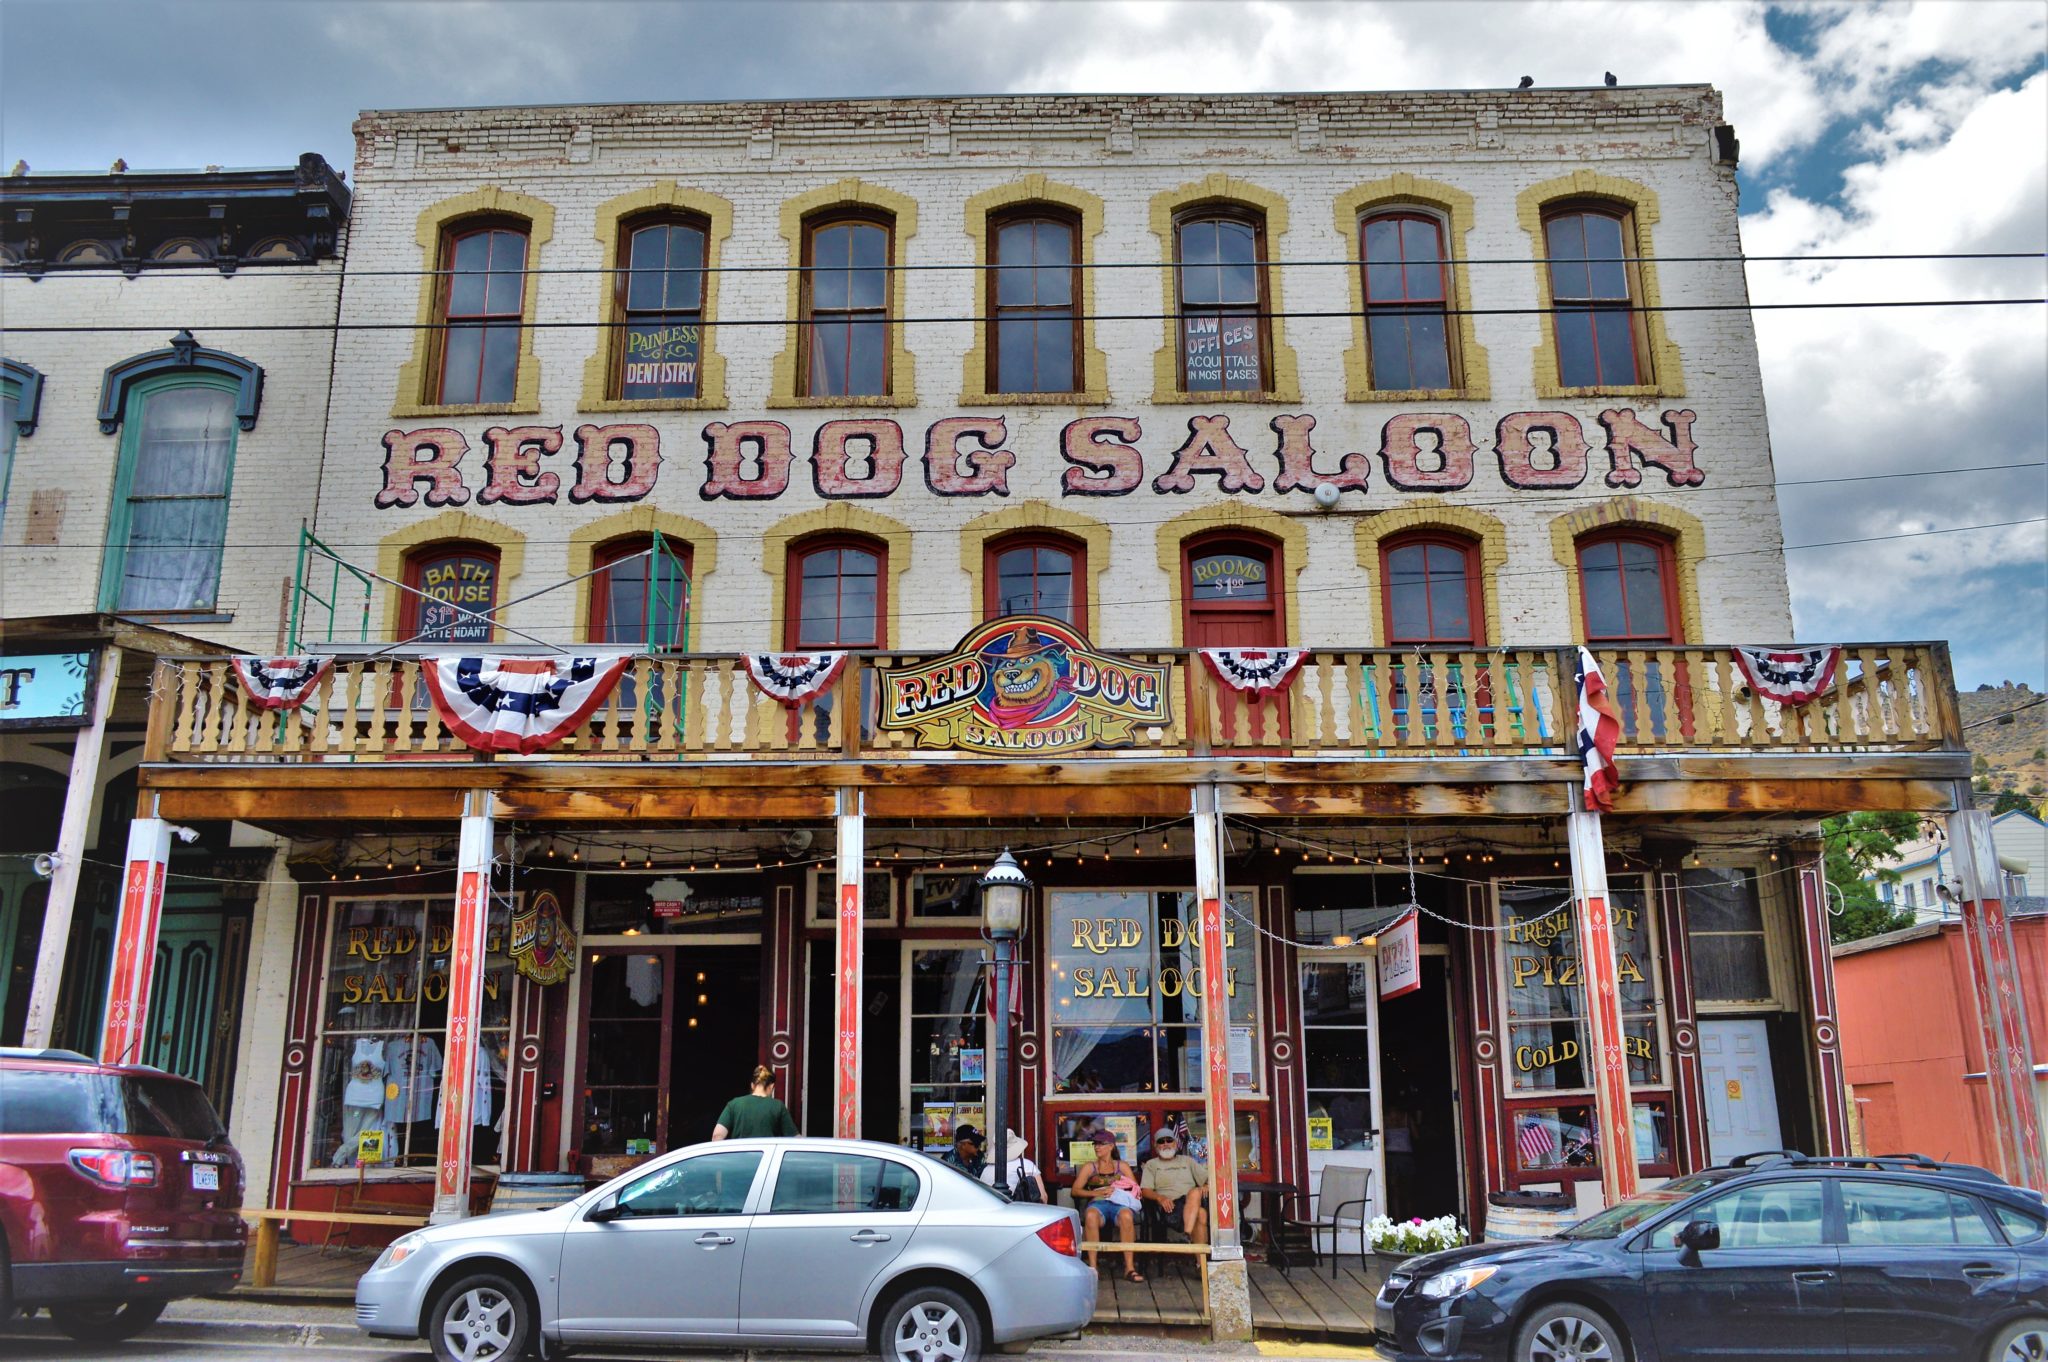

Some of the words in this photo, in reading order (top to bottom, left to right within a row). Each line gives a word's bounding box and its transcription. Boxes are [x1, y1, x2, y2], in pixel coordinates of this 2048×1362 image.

[628, 326, 699, 353] PAINLESS
[1187, 317, 1219, 333] LAW
[1187, 325, 1254, 354] OFFICES
[626, 362, 697, 384] DENTISTRY
[1187, 355, 1258, 368] ACQUITTALS
[1188, 370, 1197, 380] IN
[1198, 370, 1222, 380] MOST
[1226, 369, 1258, 380] CASES
[374, 423, 665, 509] RED
[700, 415, 1016, 502] DOG
[1059, 407, 1706, 498] SALOON
[425, 563, 490, 586] BATH
[1193, 559, 1262, 582] ROOMS
[421, 585, 490, 603] HOUSE
[421, 624, 488, 638] ATTENDANT
[895, 658, 986, 716] RED
[1067, 653, 1162, 713] DOG
[965, 720, 1088, 749] SALOON
[1071, 918, 1143, 955] RED
[1508, 912, 1570, 948] FRESH
[1610, 907, 1638, 931] OT
[347, 926, 417, 963] RED
[430, 923, 503, 954] DG
[1511, 951, 1645, 988] PIZA
[342, 970, 503, 1004] SALON
[1515, 1040, 1579, 1072] COLD
[1624, 1035, 1653, 1060] ER
